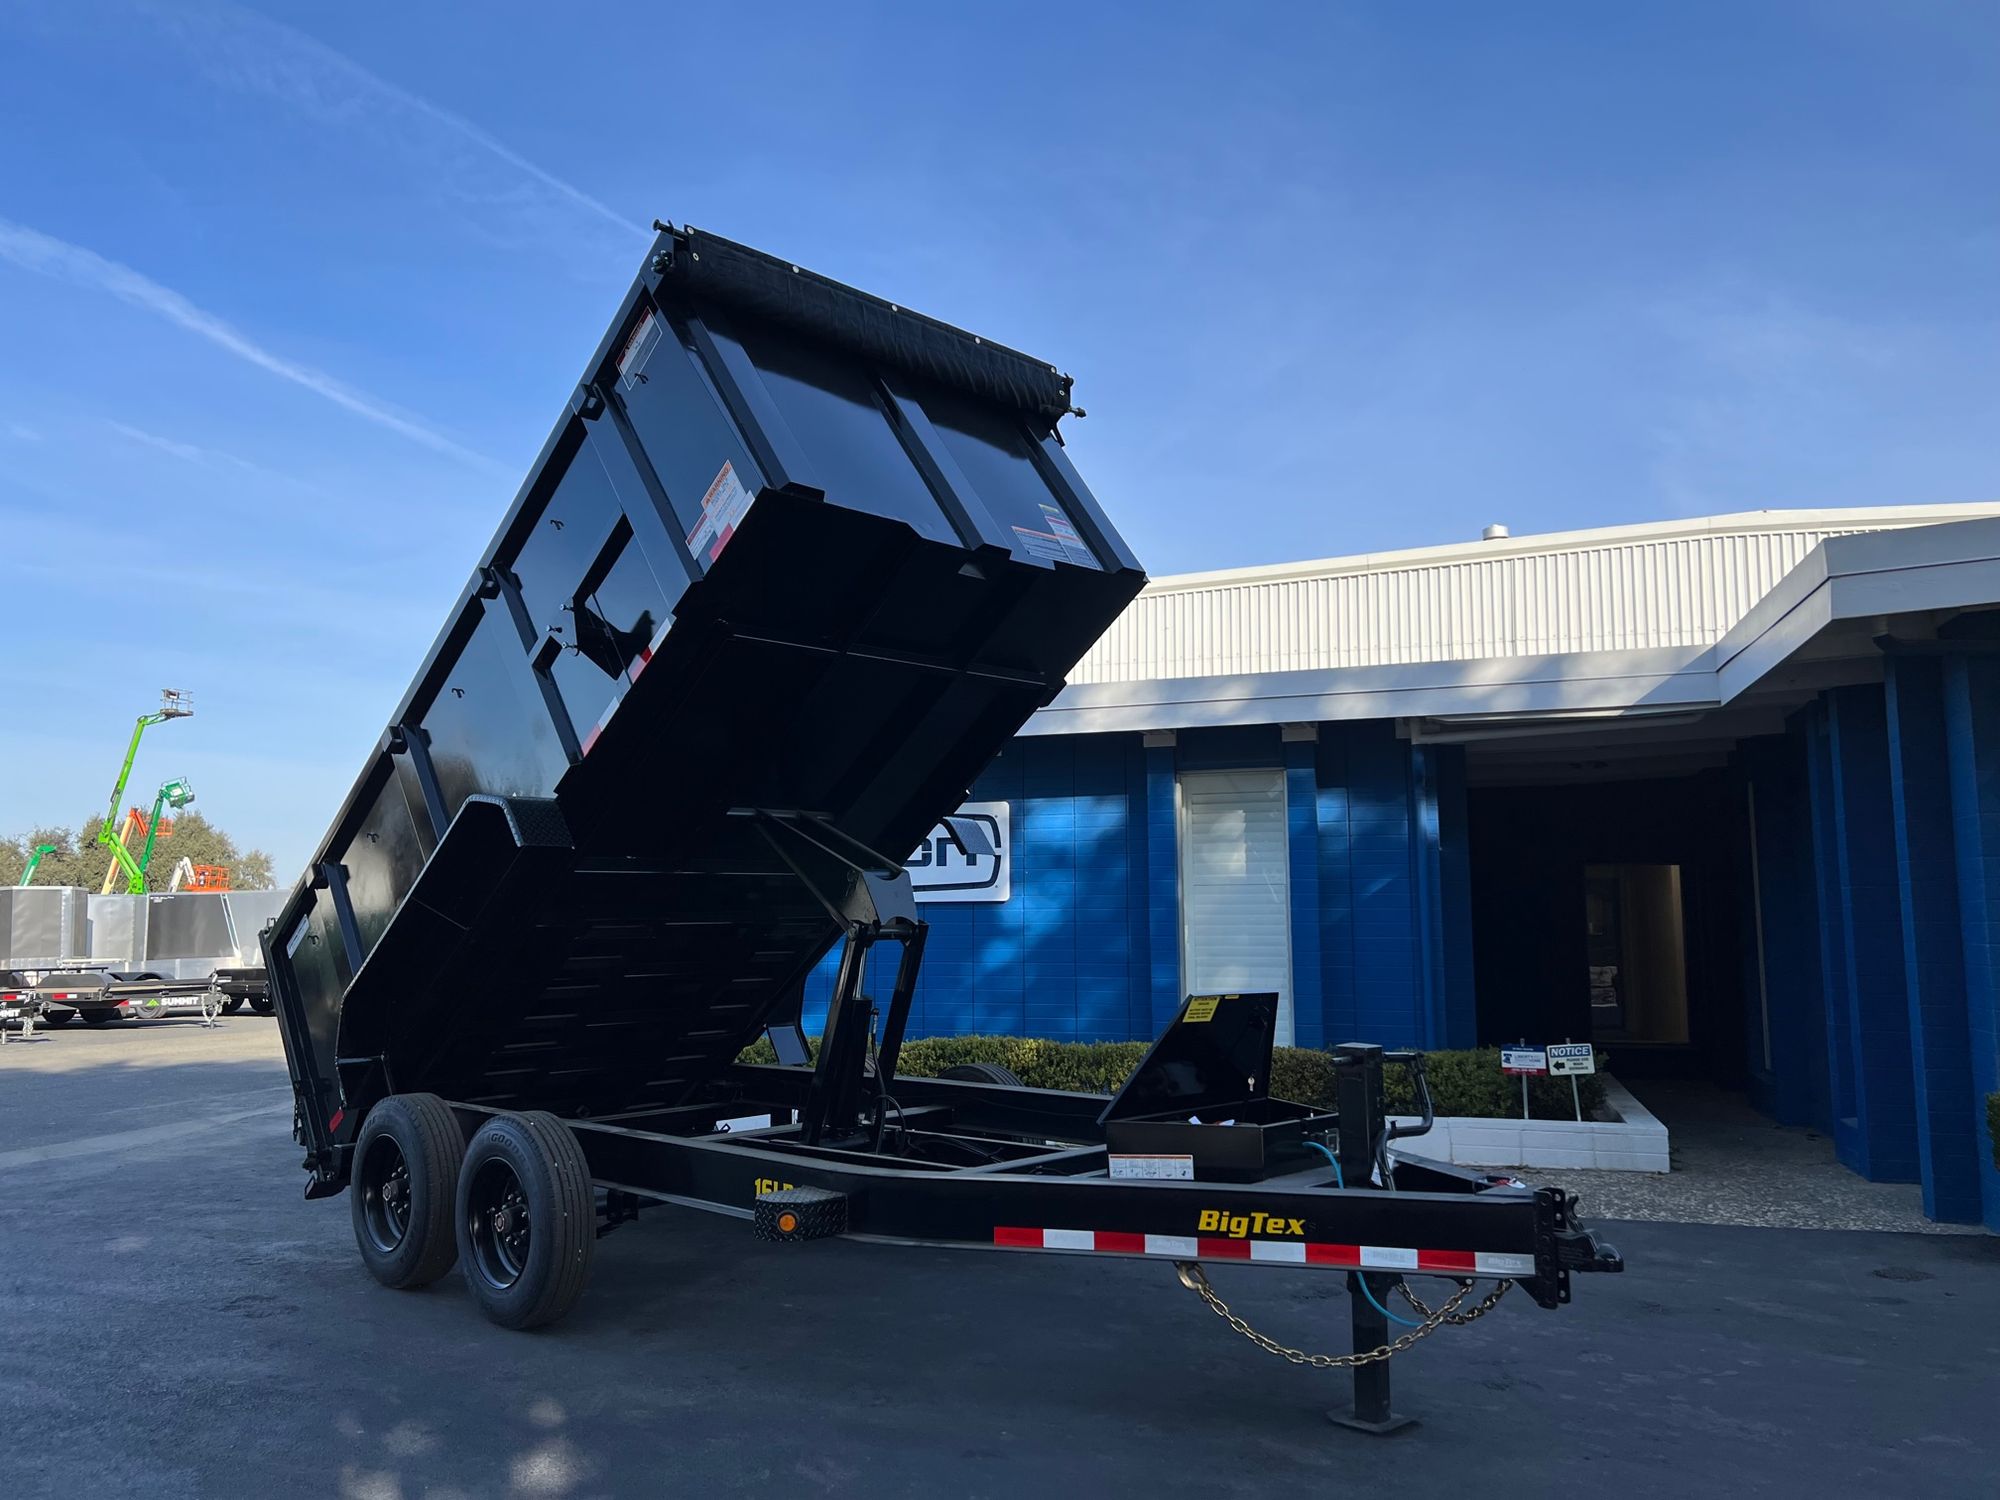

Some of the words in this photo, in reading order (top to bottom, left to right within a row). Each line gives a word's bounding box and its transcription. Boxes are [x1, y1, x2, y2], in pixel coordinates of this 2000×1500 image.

[707, 466, 729, 500] WARNING
[161, 996, 199, 1006] SUMMIT
[1550, 1046, 1590, 1057] NOTICE
[1198, 1209, 1306, 1238] BigTex
